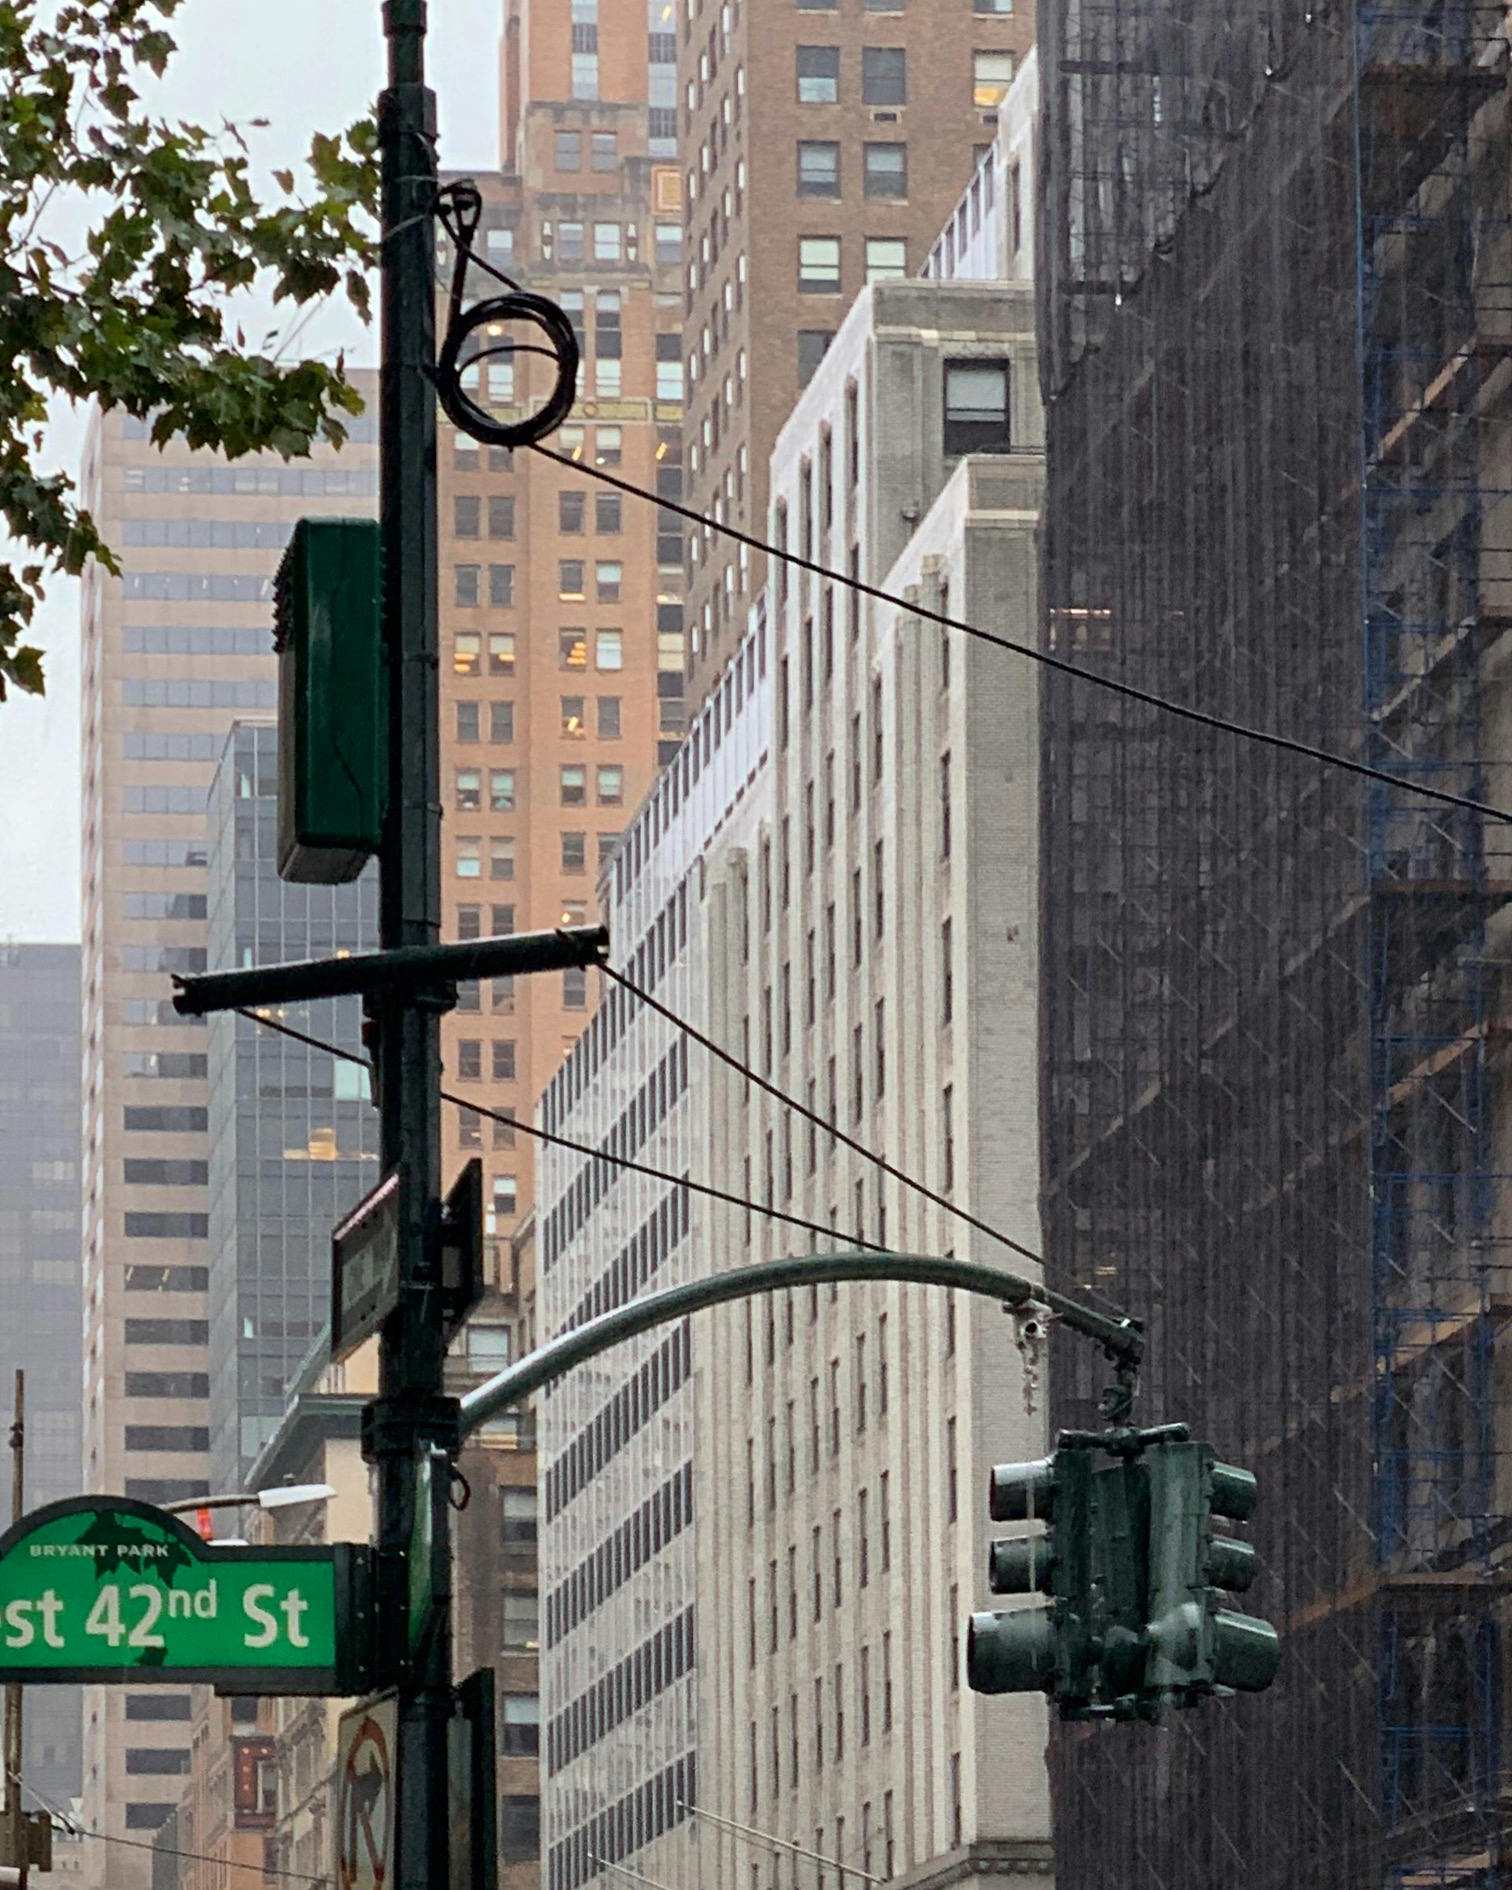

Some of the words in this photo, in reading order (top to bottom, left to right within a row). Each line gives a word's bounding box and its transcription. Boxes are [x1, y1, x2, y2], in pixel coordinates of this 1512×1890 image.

[29, 1544, 107, 1557] BRYANT
[117, 1544, 168, 1557] PARK
[85, 1578, 217, 1648] 42nd
[243, 1583, 309, 1648] St
